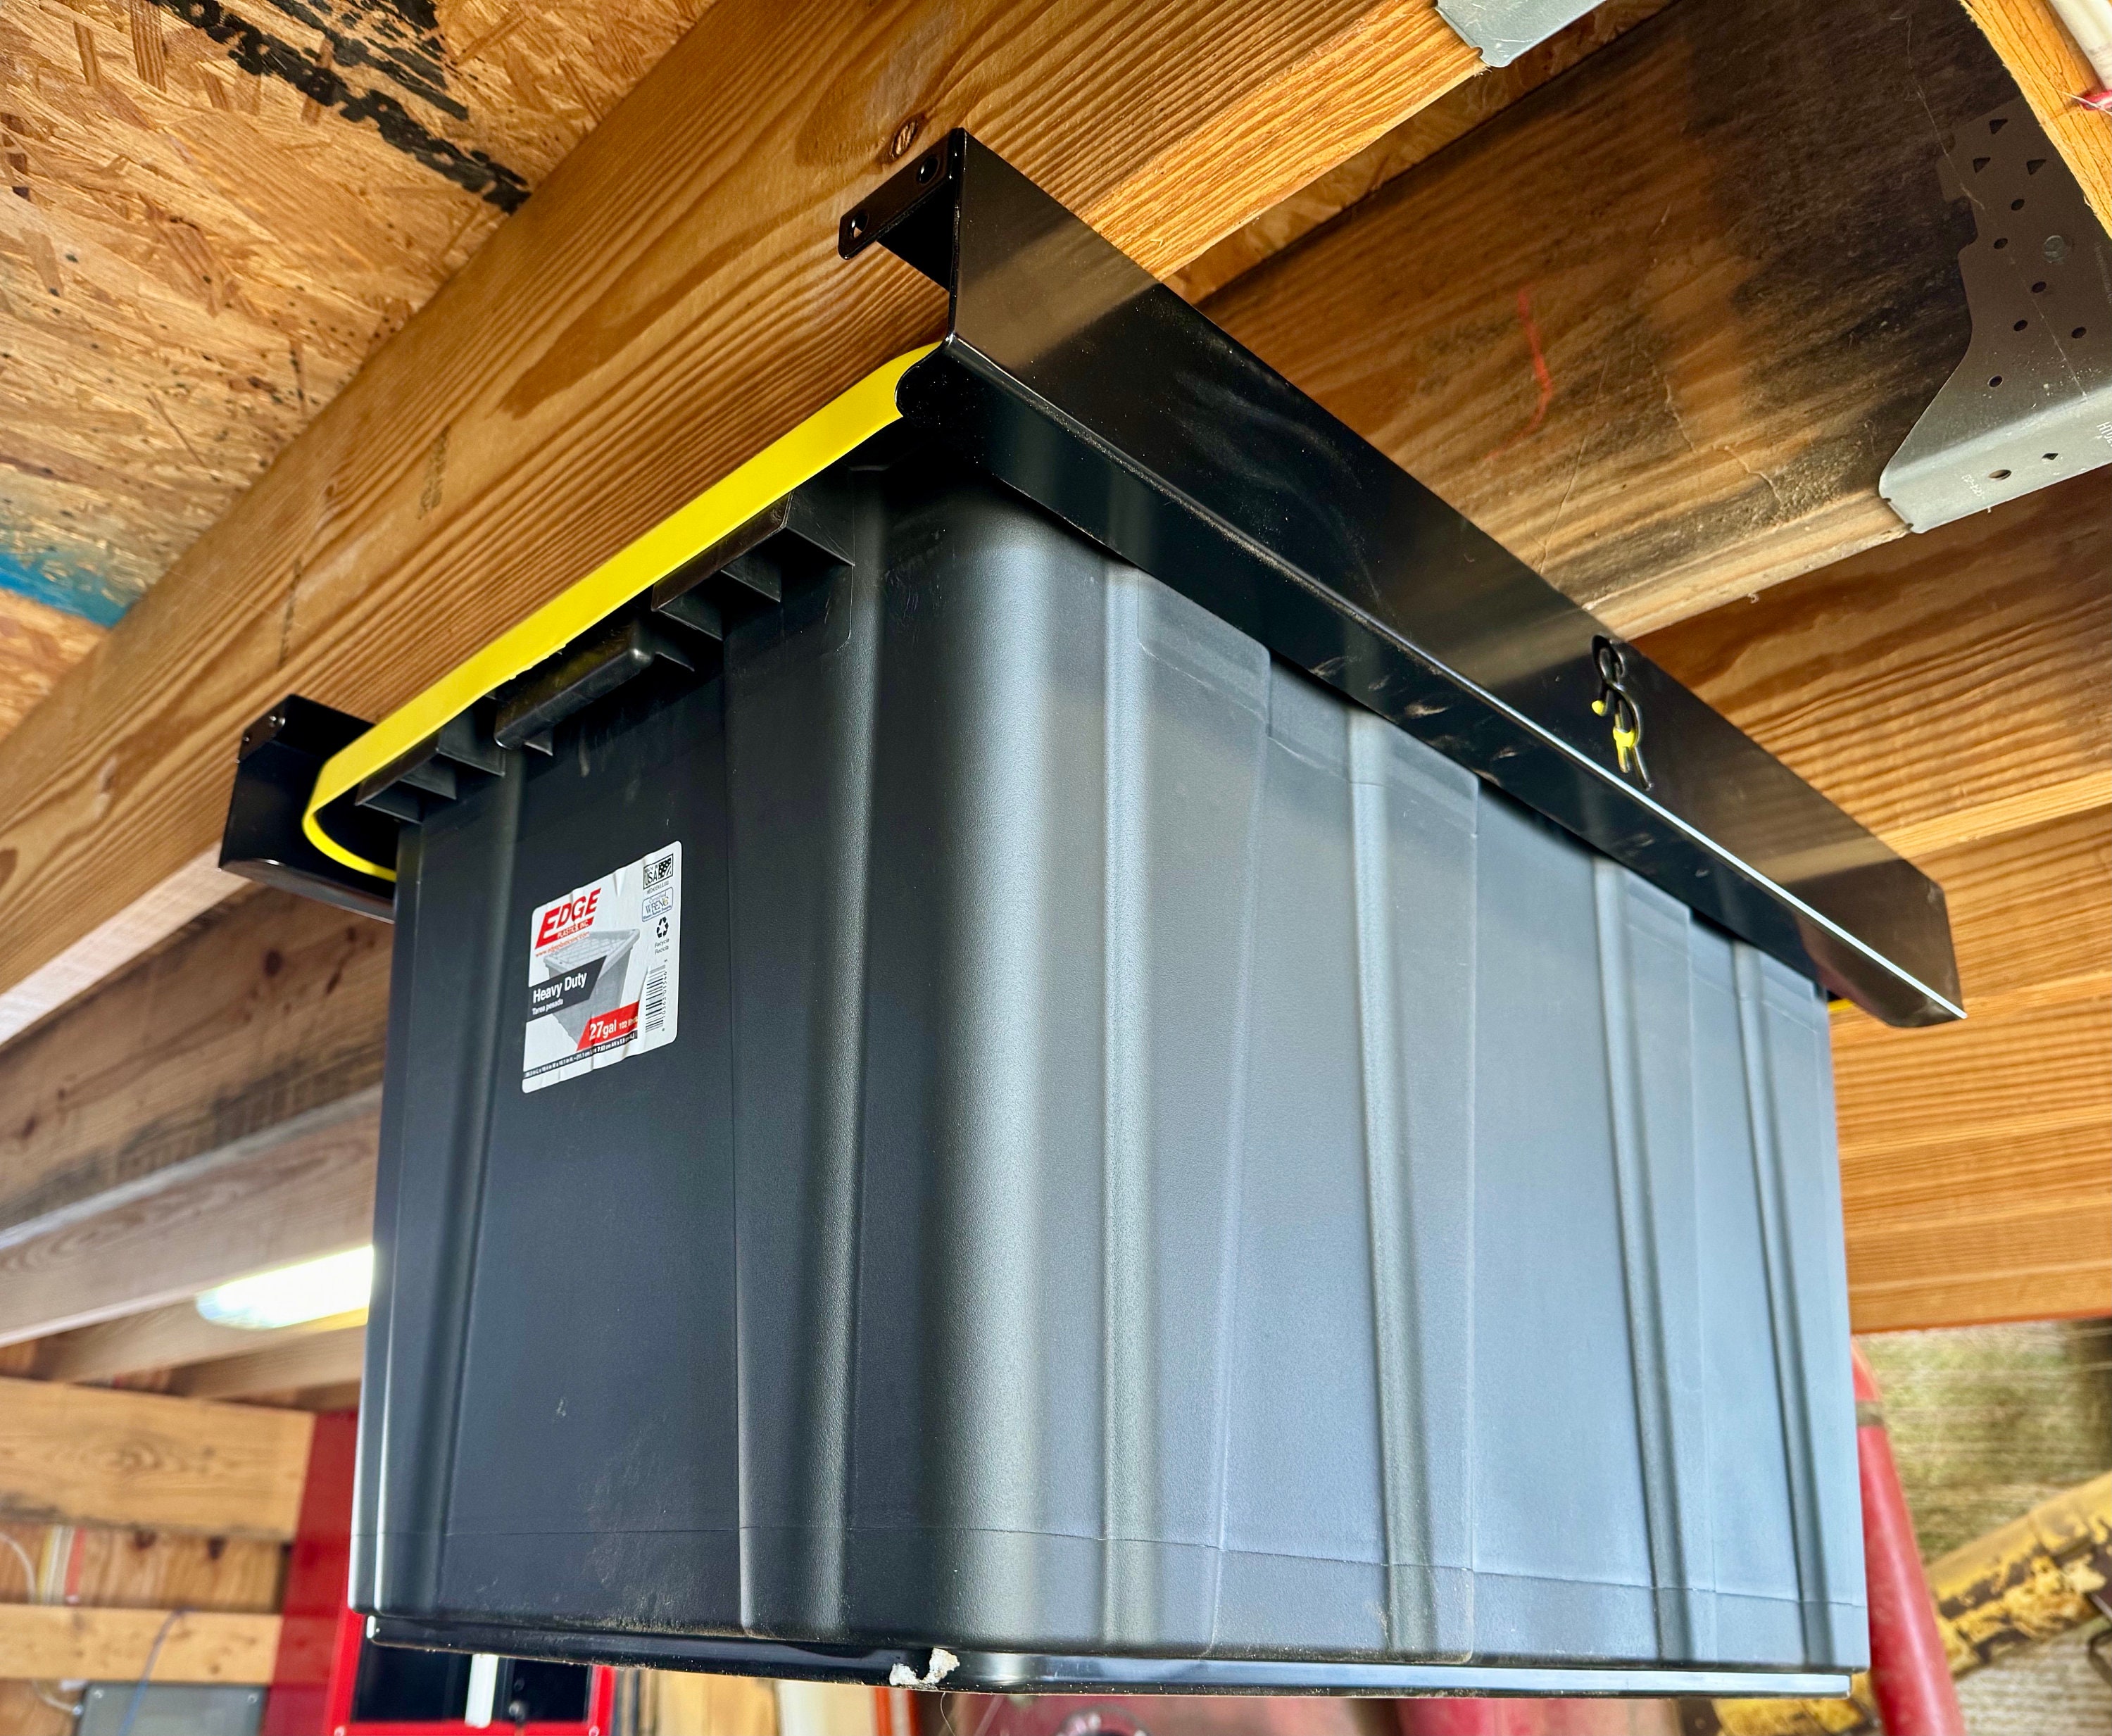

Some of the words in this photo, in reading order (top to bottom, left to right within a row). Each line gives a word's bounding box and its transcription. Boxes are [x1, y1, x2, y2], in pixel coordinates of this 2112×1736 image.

[645, 869, 658, 886] USA
[535, 888, 601, 950] EDGE
[533, 983, 562, 1003] Heavy
[565, 972, 587, 991] Duty
[589, 1019, 617, 1041] 27gal
